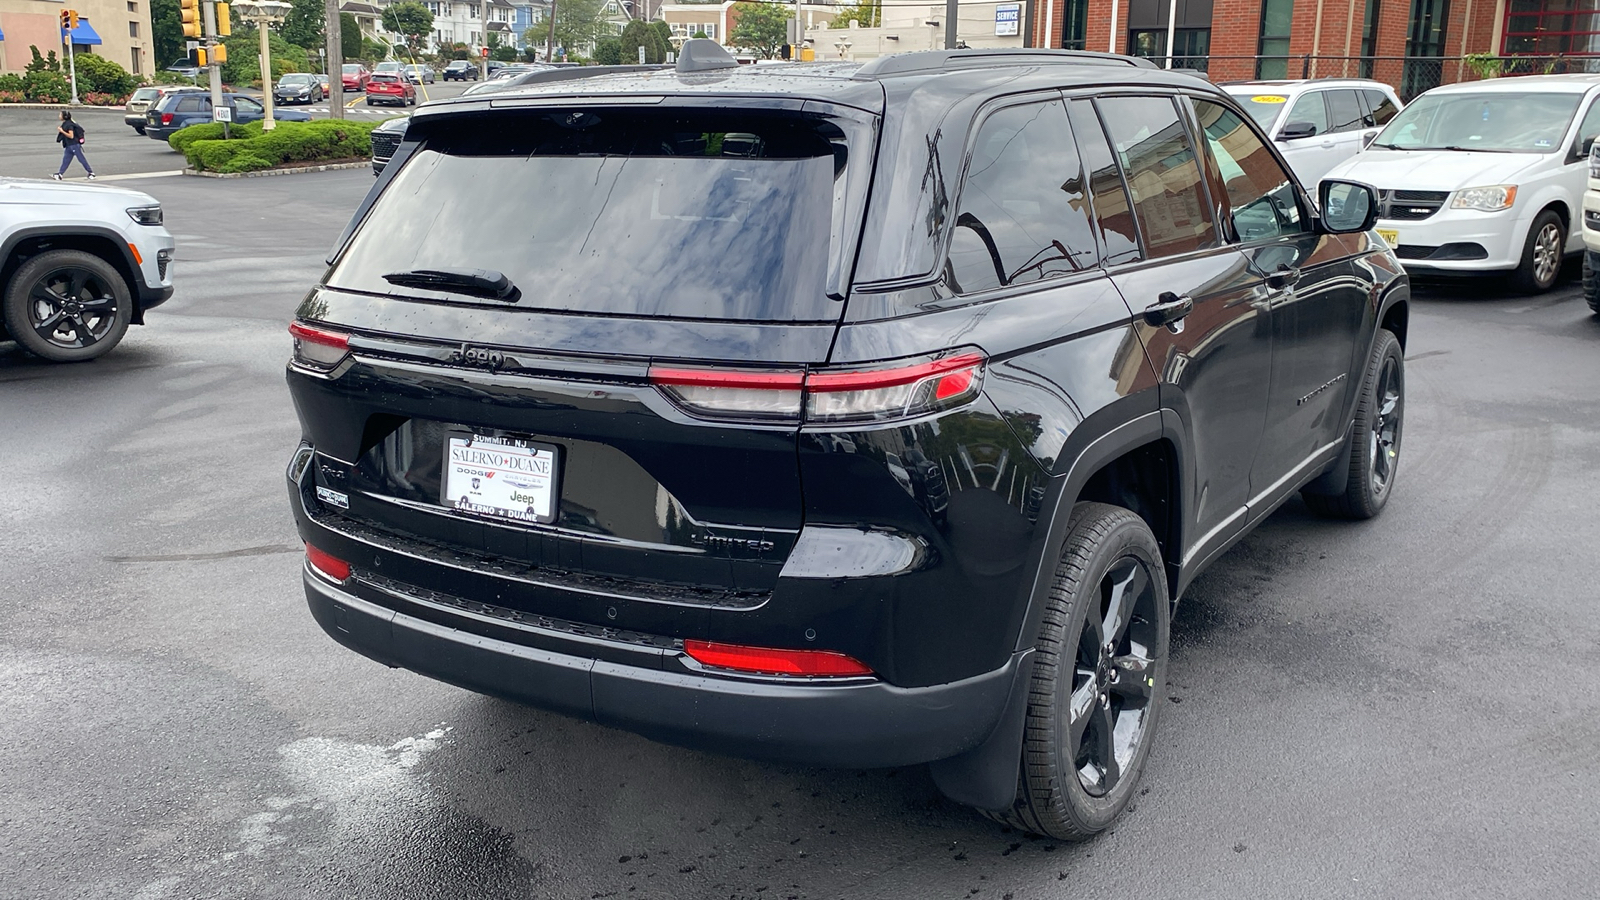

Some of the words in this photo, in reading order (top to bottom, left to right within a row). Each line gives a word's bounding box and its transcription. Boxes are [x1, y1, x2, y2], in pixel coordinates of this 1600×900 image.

[997, 11, 1018, 20] SERVICE
[451, 343, 504, 375] Jeep
[514, 439, 527, 448] NJ
[452, 448, 503, 466] SALERNO
[509, 456, 550, 474] DUANE
[509, 490, 535, 506] Jeep
[454, 501, 495, 515] SALERNO
[507, 511, 538, 522] DUANE
[691, 534, 775, 551] LIMITED
